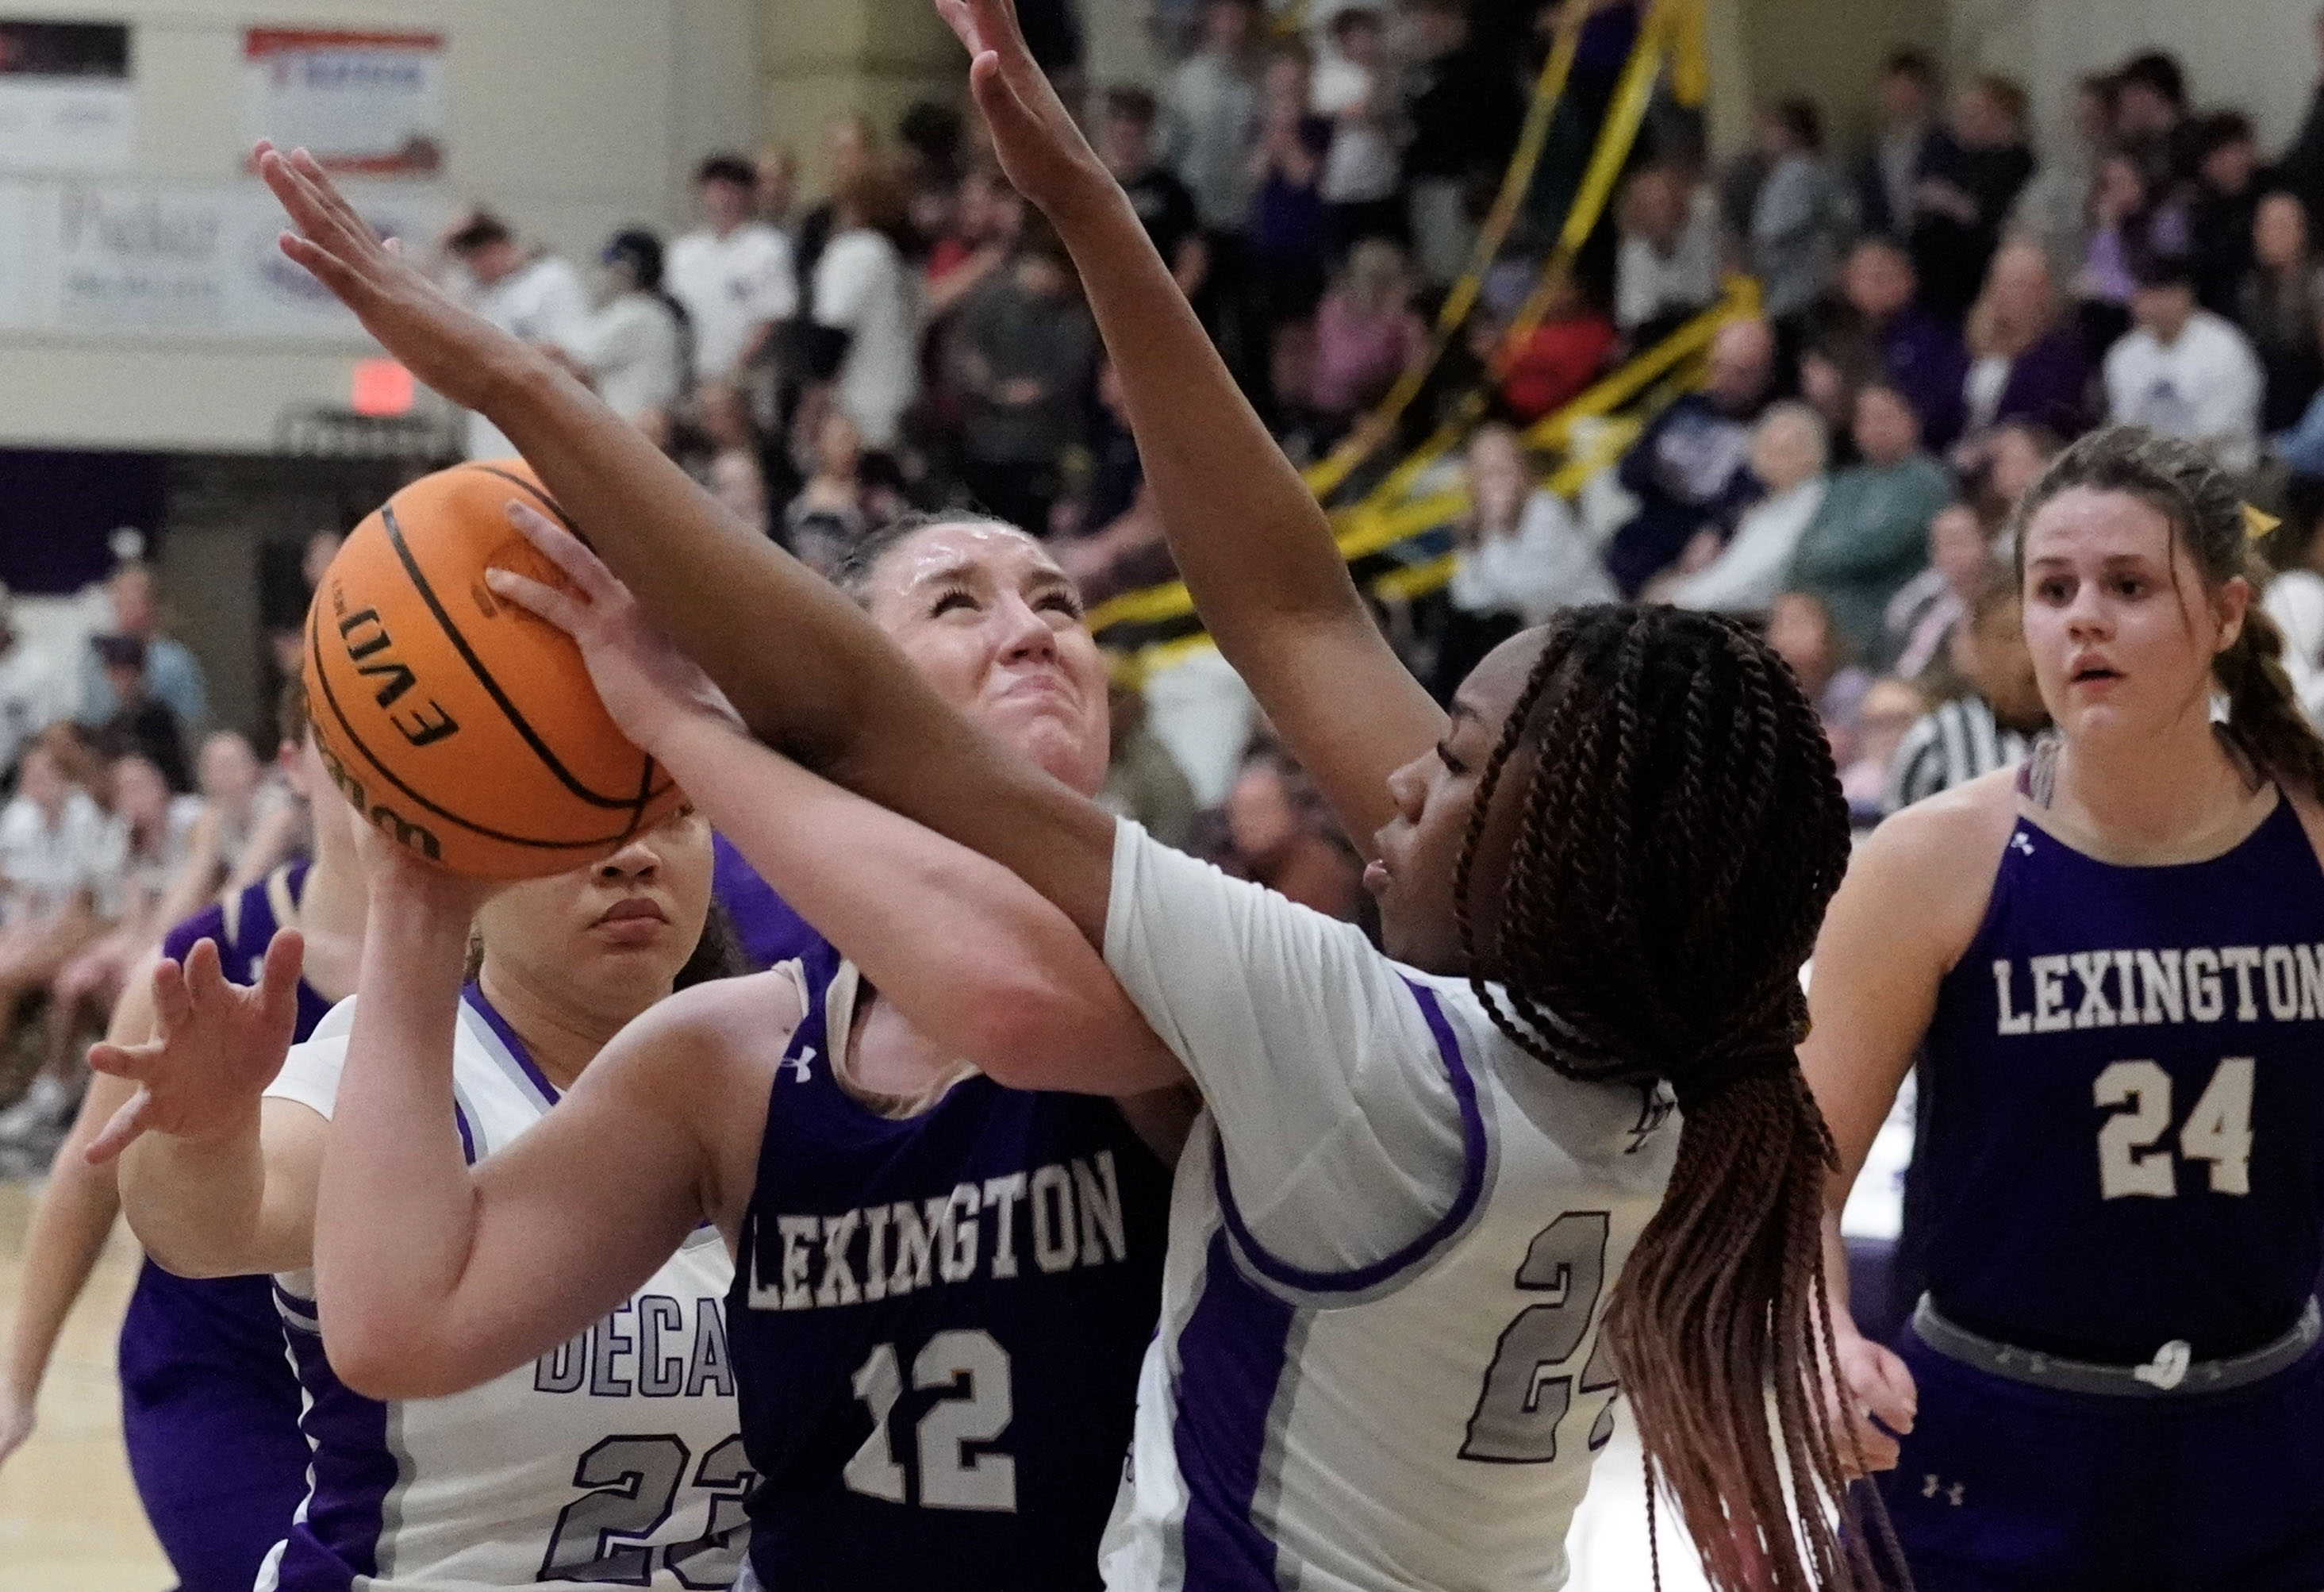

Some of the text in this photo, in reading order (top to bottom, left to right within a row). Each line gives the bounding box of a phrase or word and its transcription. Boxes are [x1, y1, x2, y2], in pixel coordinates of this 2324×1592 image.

[339, 608, 459, 746] EVO
[1992, 943, 2324, 1035] LEXINGTON
[2093, 1057, 2256, 1200] 24
[747, 1150, 1127, 1310] LEXINGTON
[844, 1329, 1018, 1513] 12
